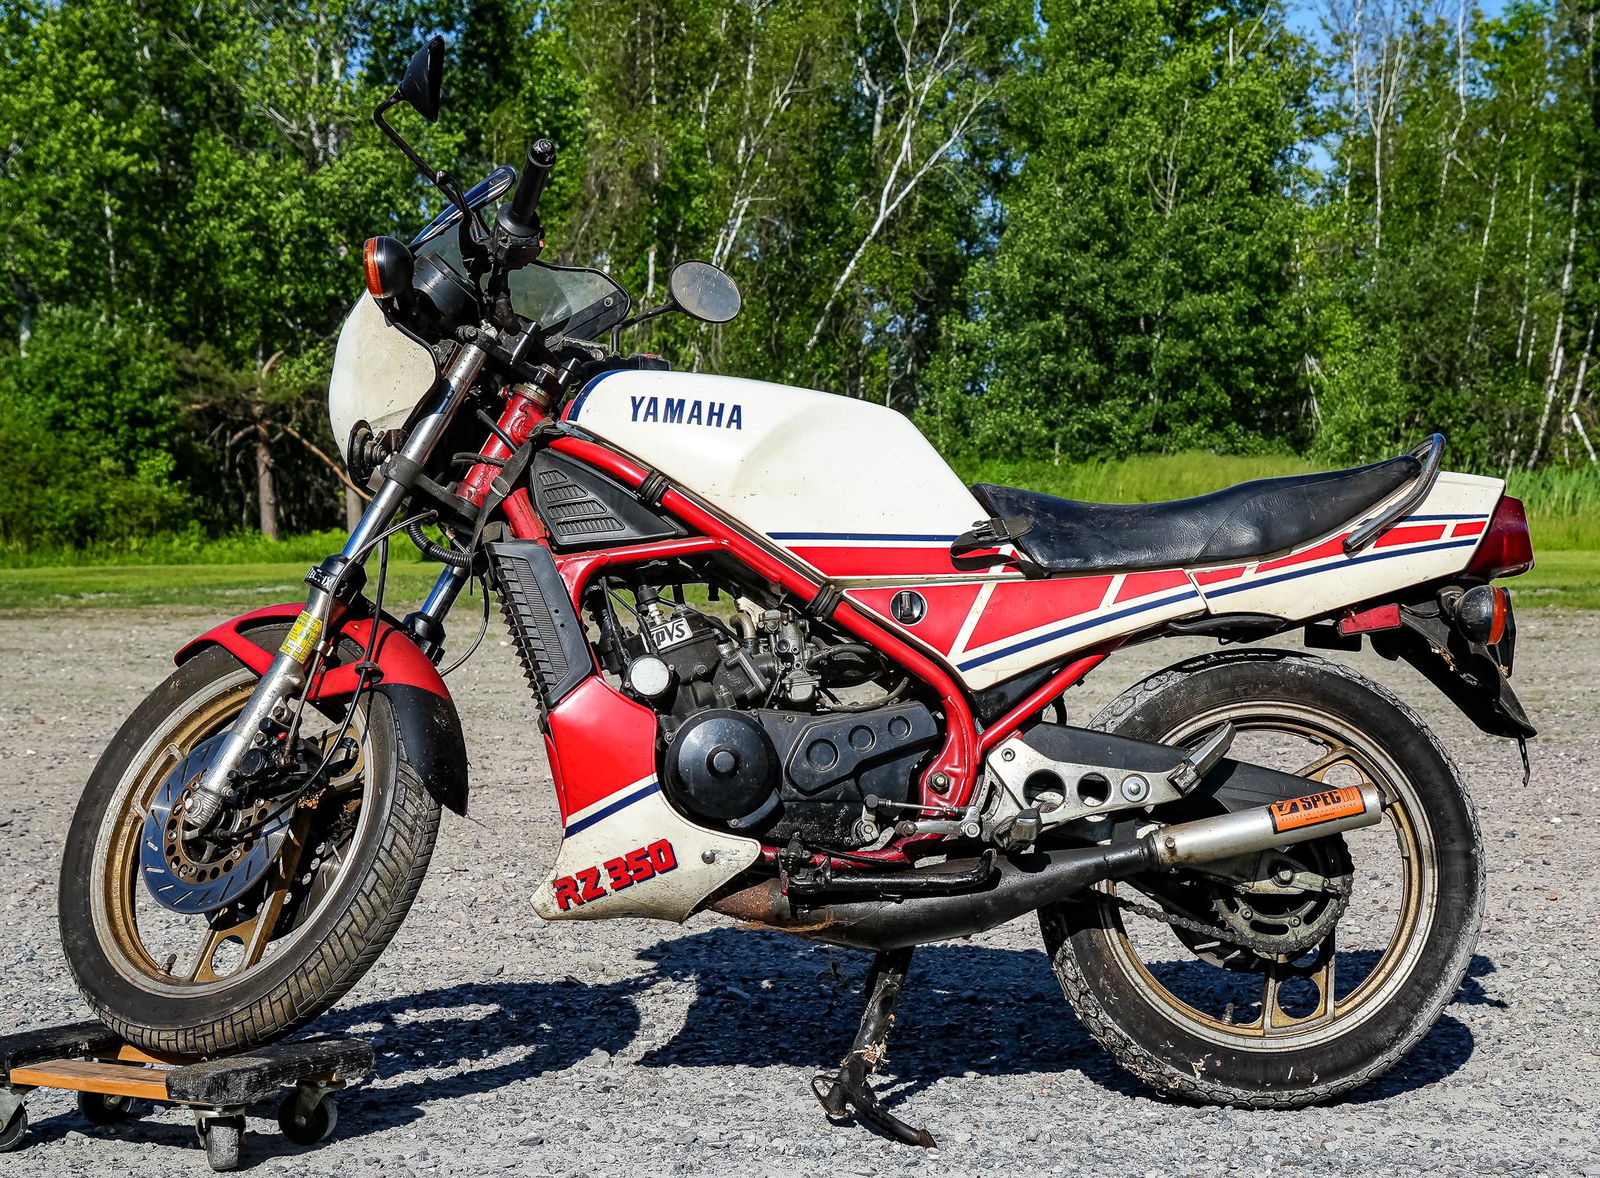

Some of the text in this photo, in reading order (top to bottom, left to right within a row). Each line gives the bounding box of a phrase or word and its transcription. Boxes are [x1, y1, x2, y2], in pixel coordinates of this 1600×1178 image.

[630, 395, 743, 431] YAMAHA
[650, 619, 686, 647] PVS
[1299, 790, 1341, 811] SPEC
[552, 838, 678, 912] RZ 350
